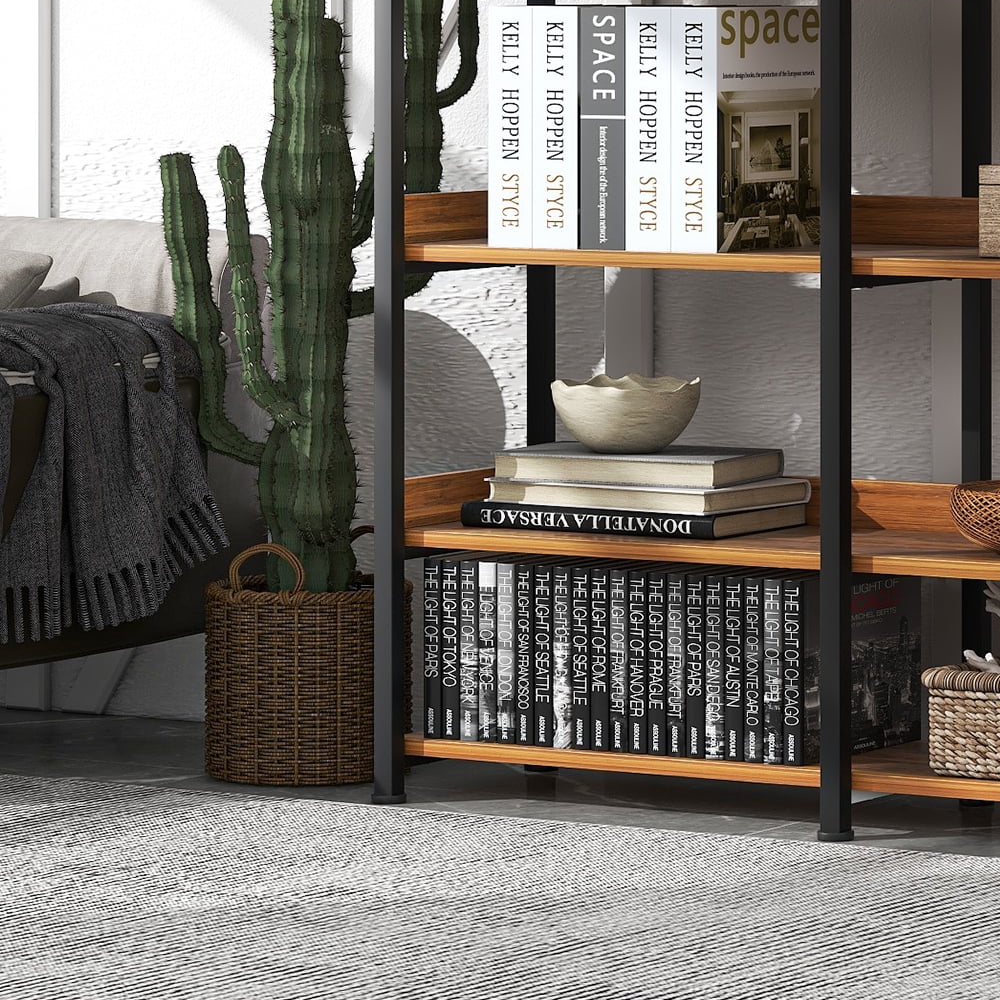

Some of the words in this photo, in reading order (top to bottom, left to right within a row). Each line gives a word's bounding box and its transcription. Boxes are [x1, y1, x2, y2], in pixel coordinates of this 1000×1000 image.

[502, 21, 519, 76] KELLY
[720, 8, 820, 58] space
[547, 22, 564, 76] KELLY
[593, 15, 616, 100] SPACE
[640, 22, 657, 77] KELLY
[685, 22, 702, 78] KELLY
[502, 89, 519, 160] HOPPEN
[547, 90, 564, 161] HOPPEN
[640, 91, 657, 163] HOPPEN
[685, 92, 702, 163] HOPPEN
[502, 174, 519, 228] STYCE
[547, 175, 564, 229] STYCE
[640, 176, 657, 231] STYCE
[685, 178, 702, 232] STYCE
[480, 508, 570, 528] VERSACE
[574, 514, 692, 534] DONATELLA
[424, 566, 438, 589] THE
[443, 567, 456, 590] THE
[462, 568, 474, 590] THE
[498, 570, 512, 592] THE
[518, 571, 529, 590] THE
[536, 572, 549, 595] THE
[554, 573, 567, 594] THE
[573, 574, 587, 598] THE
[592, 576, 606, 599] THE
[610, 577, 624, 598] THE
[630, 578, 644, 601] THE
[649, 579, 663, 602] THE
[668, 580, 681, 602] THE
[687, 582, 701, 604] THE
[853, 581, 883, 594] LIGHT
[885, 578, 900, 589] OF
[424, 591, 438, 624] LIGHT
[443, 592, 456, 625] LIGHT
[462, 592, 474, 624] LIGHT
[518, 591, 529, 618] LIGHT
[706, 582, 720, 605] THE
[726, 584, 740, 607] THE
[747, 585, 758, 605] THE
[765, 586, 779, 609] THE
[785, 587, 799, 611] THE
[480, 595, 493, 628] LIGHT
[498, 595, 512, 629] LIGHT
[518, 619, 529, 632] OF
[536, 597, 549, 632] LIGHT
[554, 596, 567, 626] LIGHT
[573, 600, 587, 634] LIGHT
[592, 601, 606, 635] LIGHT
[610, 600, 624, 631] LIGHT
[630, 603, 644, 638] LIGHT
[649, 605, 663, 639] LIGHT
[668, 604, 681, 635] LIGHT
[687, 606, 701, 641] LIGHT
[706, 606, 720, 640] LIGHT
[726, 609, 740, 644] LIGHT
[747, 606, 758, 634] LIGHT
[424, 626, 438, 643] OF
[443, 626, 456, 644] OF
[462, 625, 474, 641] OF
[480, 629, 493, 646] OF
[498, 630, 512, 647] OF
[518, 633, 529, 652] SAN
[536, 633, 549, 650] OF
[554, 627, 567, 642] OF
[573, 635, 587, 653] OF
[610, 633, 624, 648] OF
[747, 636, 758, 650] OF
[765, 612, 779, 646] LIGHT
[785, 613, 799, 648] LIGHT
[592, 637, 606, 654] OF
[630, 639, 644, 656] OF
[649, 640, 663, 658] OF
[668, 637, 681, 653] OF
[687, 643, 701, 660] OF
[706, 641, 720, 658] OF
[726, 646, 740, 663] OF
[765, 648, 779, 665] OF
[785, 649, 799, 667] OF
[424, 644, 438, 678] PARIS
[443, 646, 456, 687] TOKYO
[480, 647, 493, 690] VENICE
[498, 650, 512, 701] LONDON
[592, 655, 606, 692] ROME
[706, 660, 720, 683] SAN
[747, 653, 758, 689] MONTE
[462, 671, 474, 703] YORK
[518, 655, 529, 709] FRANCISCO
[536, 651, 549, 703] SEATTLE
[573, 654, 587, 705] SEATTLE
[610, 650, 624, 715] FRANKFURT
[630, 658, 644, 717] HANOVER
[649, 660, 663, 710] PRAGUE
[668, 654, 681, 719] FRANKFURT
[687, 662, 701, 696] PARIS
[726, 664, 740, 707] AUSTIN
[747, 690, 758, 726] CARLO
[785, 669, 799, 725] CHICAGO
